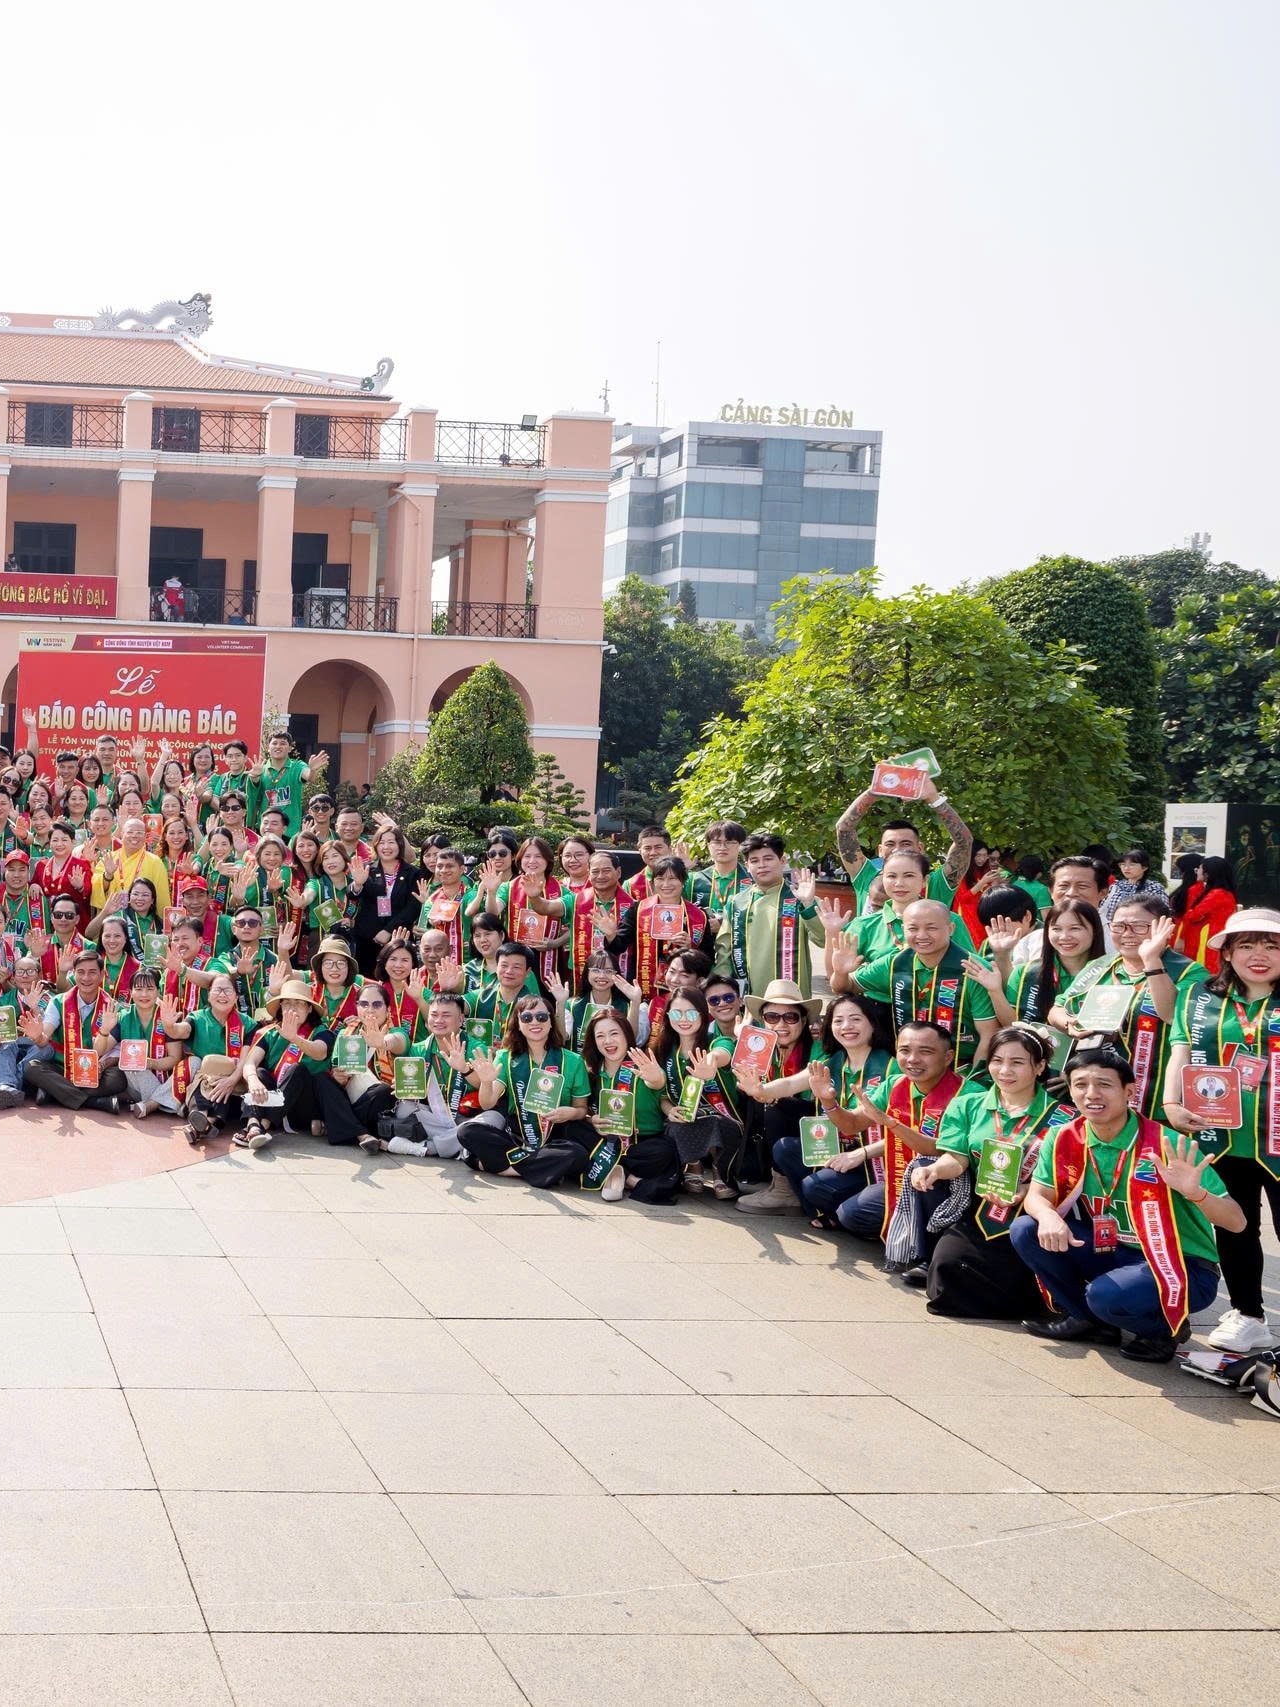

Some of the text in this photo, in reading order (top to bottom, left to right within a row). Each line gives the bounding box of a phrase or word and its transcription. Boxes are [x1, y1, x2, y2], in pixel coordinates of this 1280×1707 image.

[720, 398, 853, 428] CẢNG SÀI GÒN
[28, 583, 51, 603] BÁC
[53, 581, 70, 605] HỒ
[72, 585, 84, 605] VĨ
[26, 638, 41, 646] VNV
[110, 665, 163, 696] Lễ
[38, 699, 237, 735] BÁO CÔNG DÂNG BÁC
[47, 734, 57, 744] LỄ
[60, 736, 77, 744] TÔN
[783, 899, 797, 917] VNV
[692, 924, 705, 945] VNV
[895, 980, 905, 1005] Danh
[938, 979, 959, 1008] VNV
[1026, 984, 1040, 1010] Danh
[1192, 993, 1211, 1045] Danh hiệu
[230, 1025, 241, 1047] VNV
[450, 1089, 462, 1112] NGƯỜI
[516, 1080, 539, 1145] Danh NGƯỜI
[921, 1109, 942, 1137] VNV
[588, 1161, 603, 1181] 2025
[1134, 1147, 1159, 1184] VNV
[1146, 1203, 1179, 1305] CỘNG ĐỒNG TÌNH NGUYỆN VIỆT NAM
